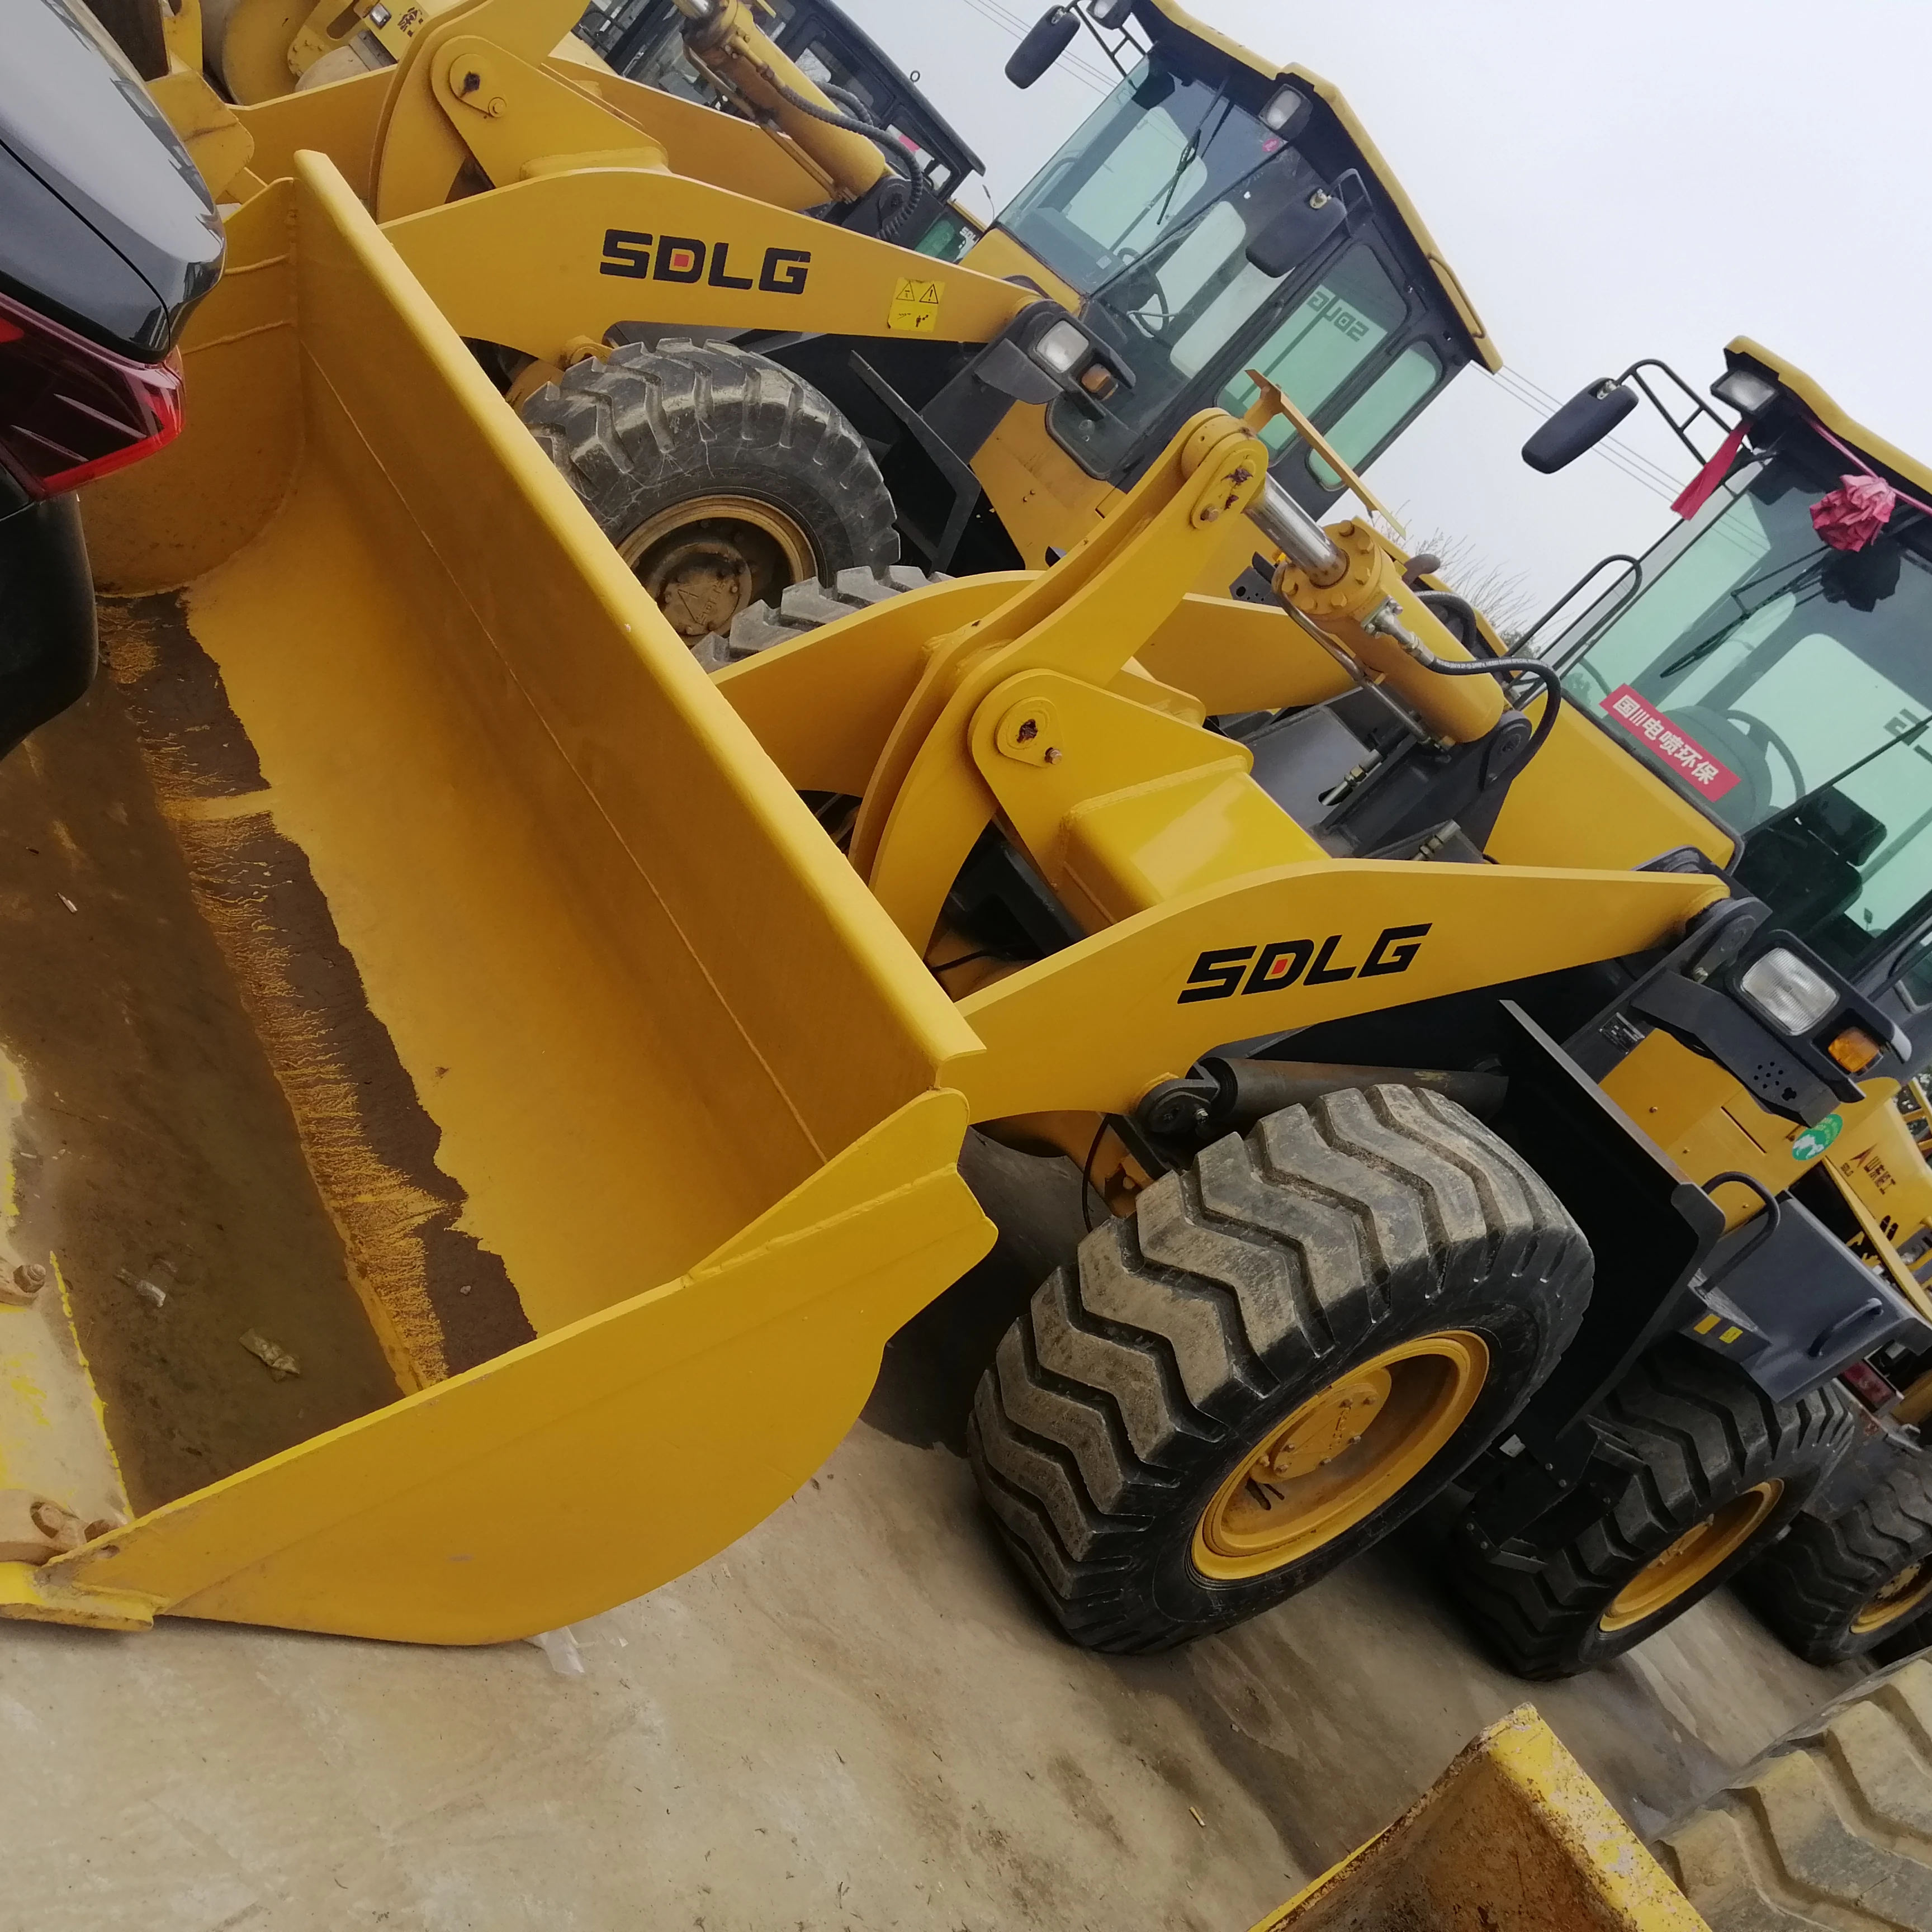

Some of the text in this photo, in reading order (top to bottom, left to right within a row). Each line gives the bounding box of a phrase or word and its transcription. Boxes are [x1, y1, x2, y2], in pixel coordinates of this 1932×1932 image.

[600, 229, 811, 295] SDLG
[959, 226, 980, 244] SDL
[1177, 922, 1433, 1004] SDLG
